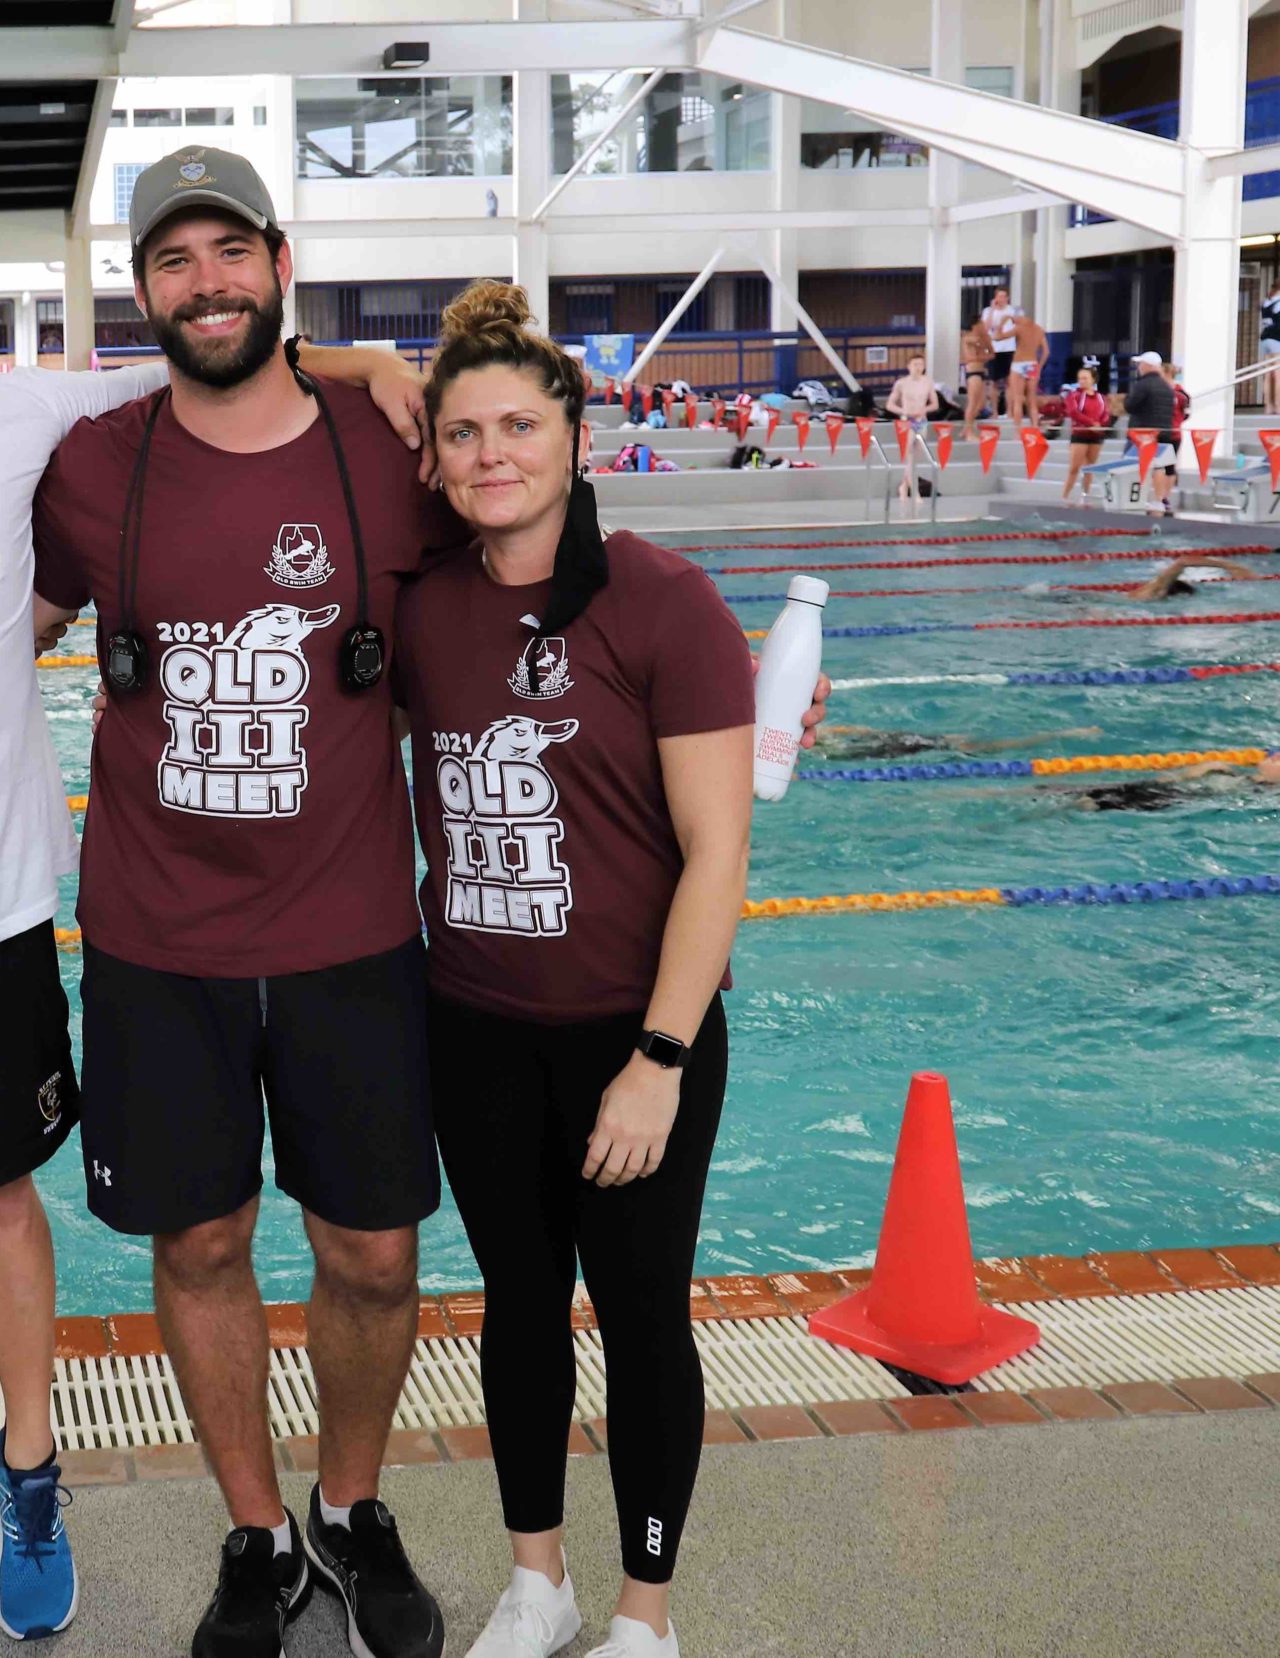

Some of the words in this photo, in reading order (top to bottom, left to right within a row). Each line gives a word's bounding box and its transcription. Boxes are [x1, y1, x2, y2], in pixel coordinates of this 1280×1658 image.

[1130, 482, 1141, 502] 8
[275, 575, 289, 584] QLD
[307, 575, 324, 585] TEAM
[156, 622, 224, 642] 2021
[162, 646, 307, 707] QLD
[543, 688, 560, 697] TEAM
[165, 703, 307, 768] III
[433, 732, 472, 753] 2021
[159, 762, 306, 815] MEET
[438, 756, 556, 817] QLD
[444, 817, 567, 884] III
[447, 878, 570, 933] MEET
